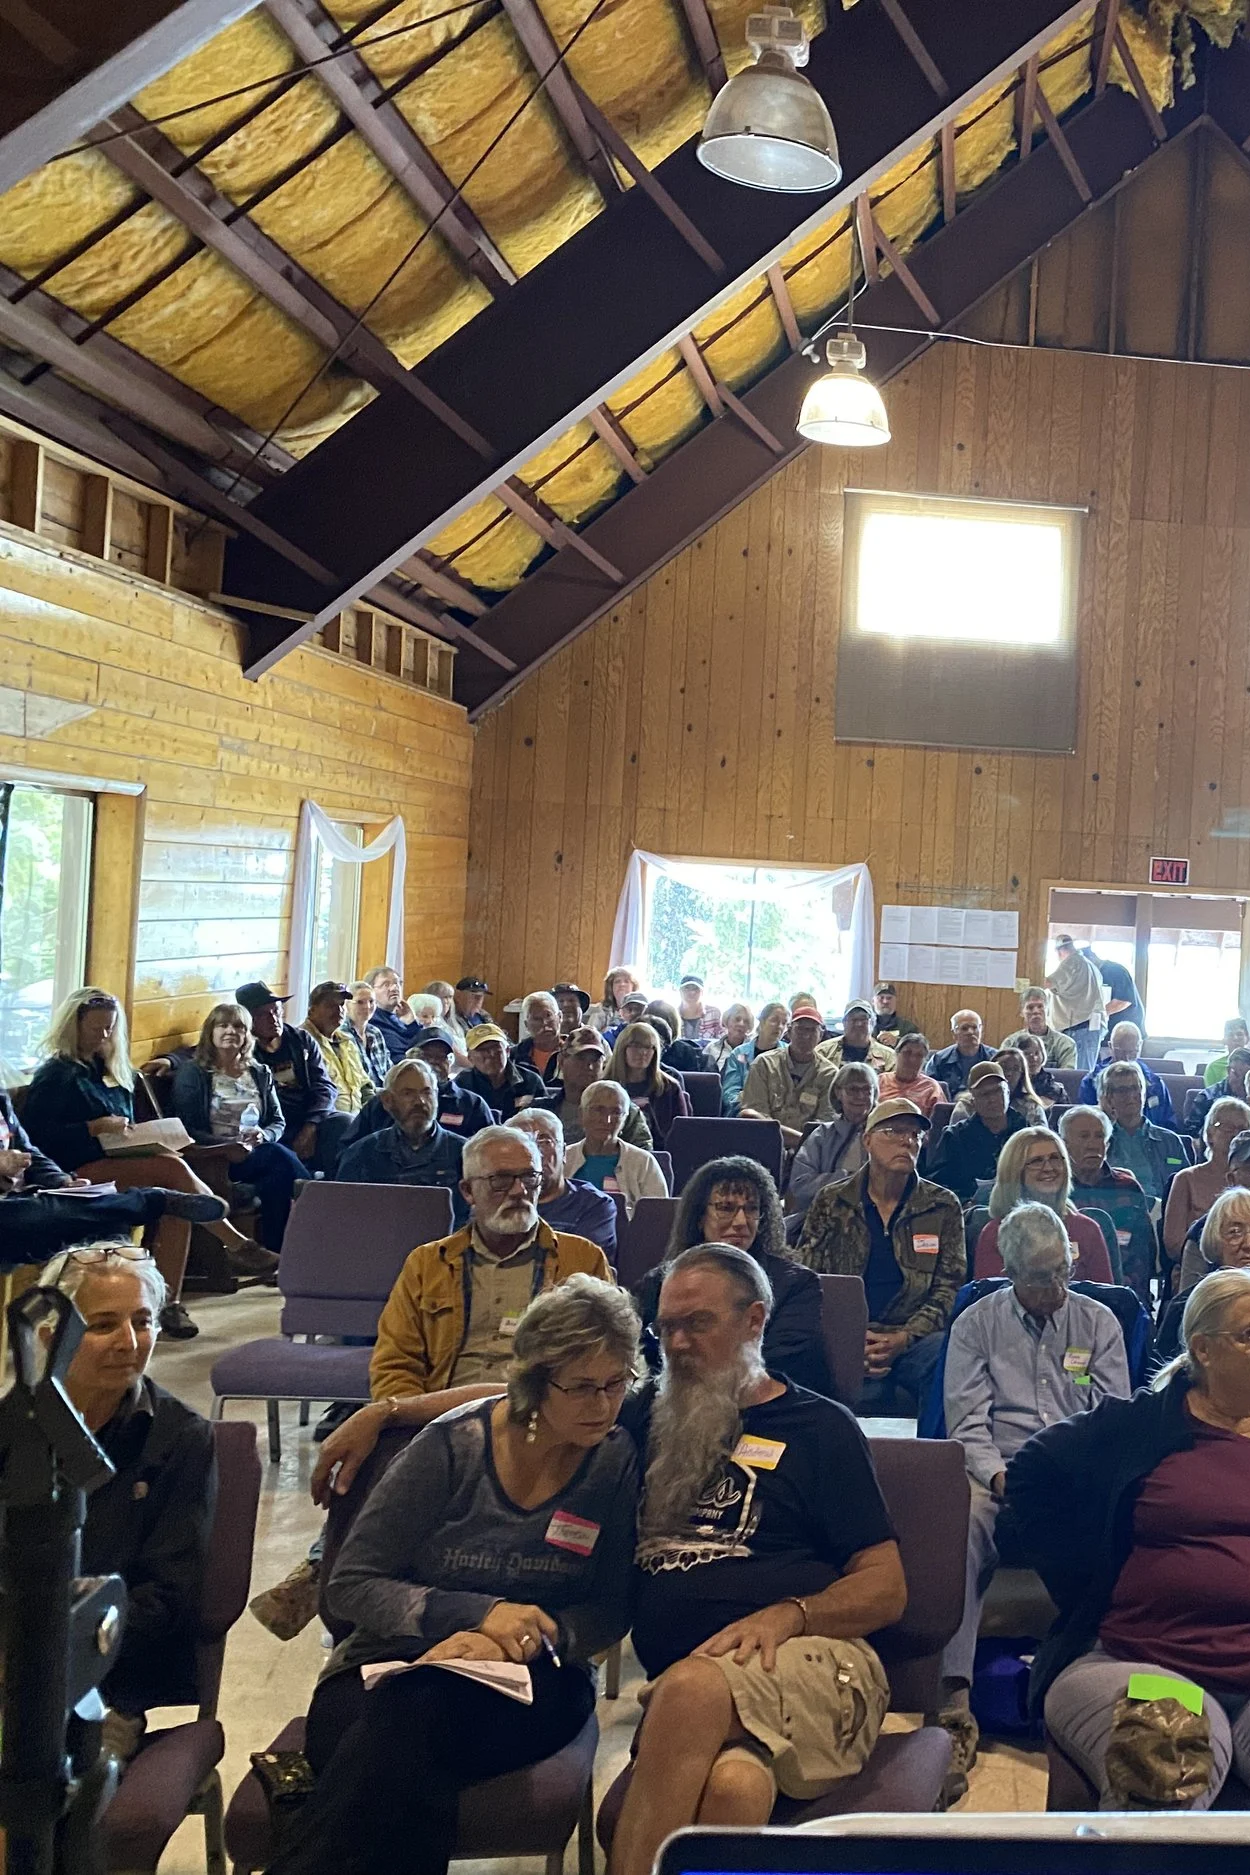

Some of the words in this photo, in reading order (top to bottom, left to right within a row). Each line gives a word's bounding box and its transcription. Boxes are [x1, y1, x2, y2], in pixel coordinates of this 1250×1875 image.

[1153, 860, 1186, 881] EXIT
[443, 1548, 502, 1572] Harley
[506, 1552, 582, 1578] Davids
